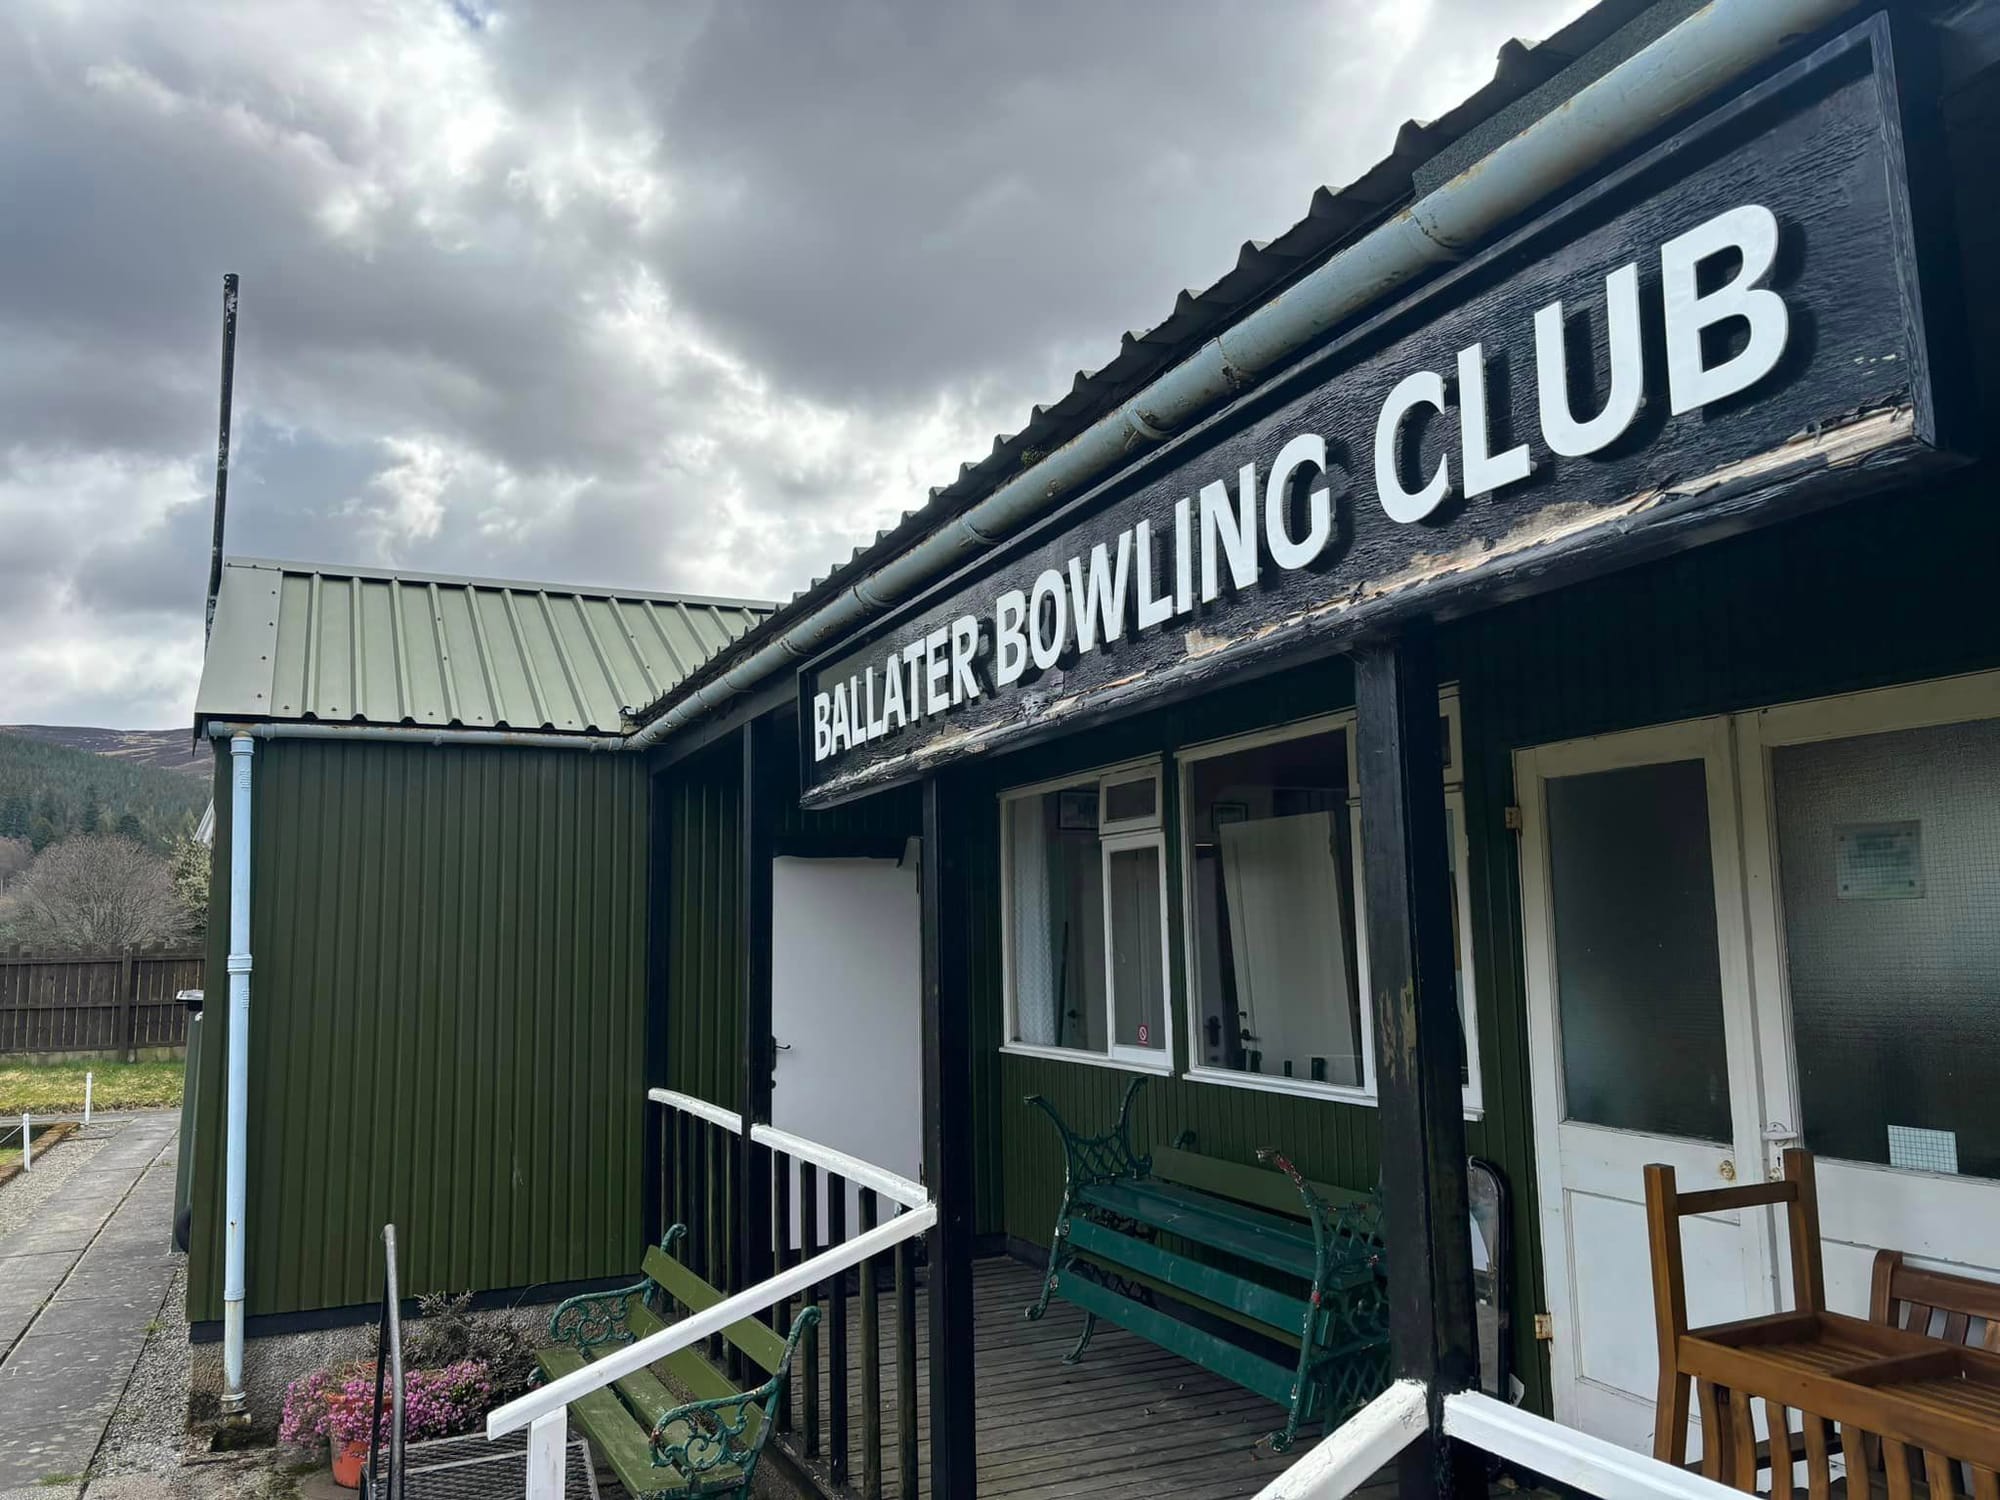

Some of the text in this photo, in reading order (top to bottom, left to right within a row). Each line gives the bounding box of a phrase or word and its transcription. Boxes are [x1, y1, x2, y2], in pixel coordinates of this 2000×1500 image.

[814, 204, 1789, 762] BALLATER BOWLING CLUB
